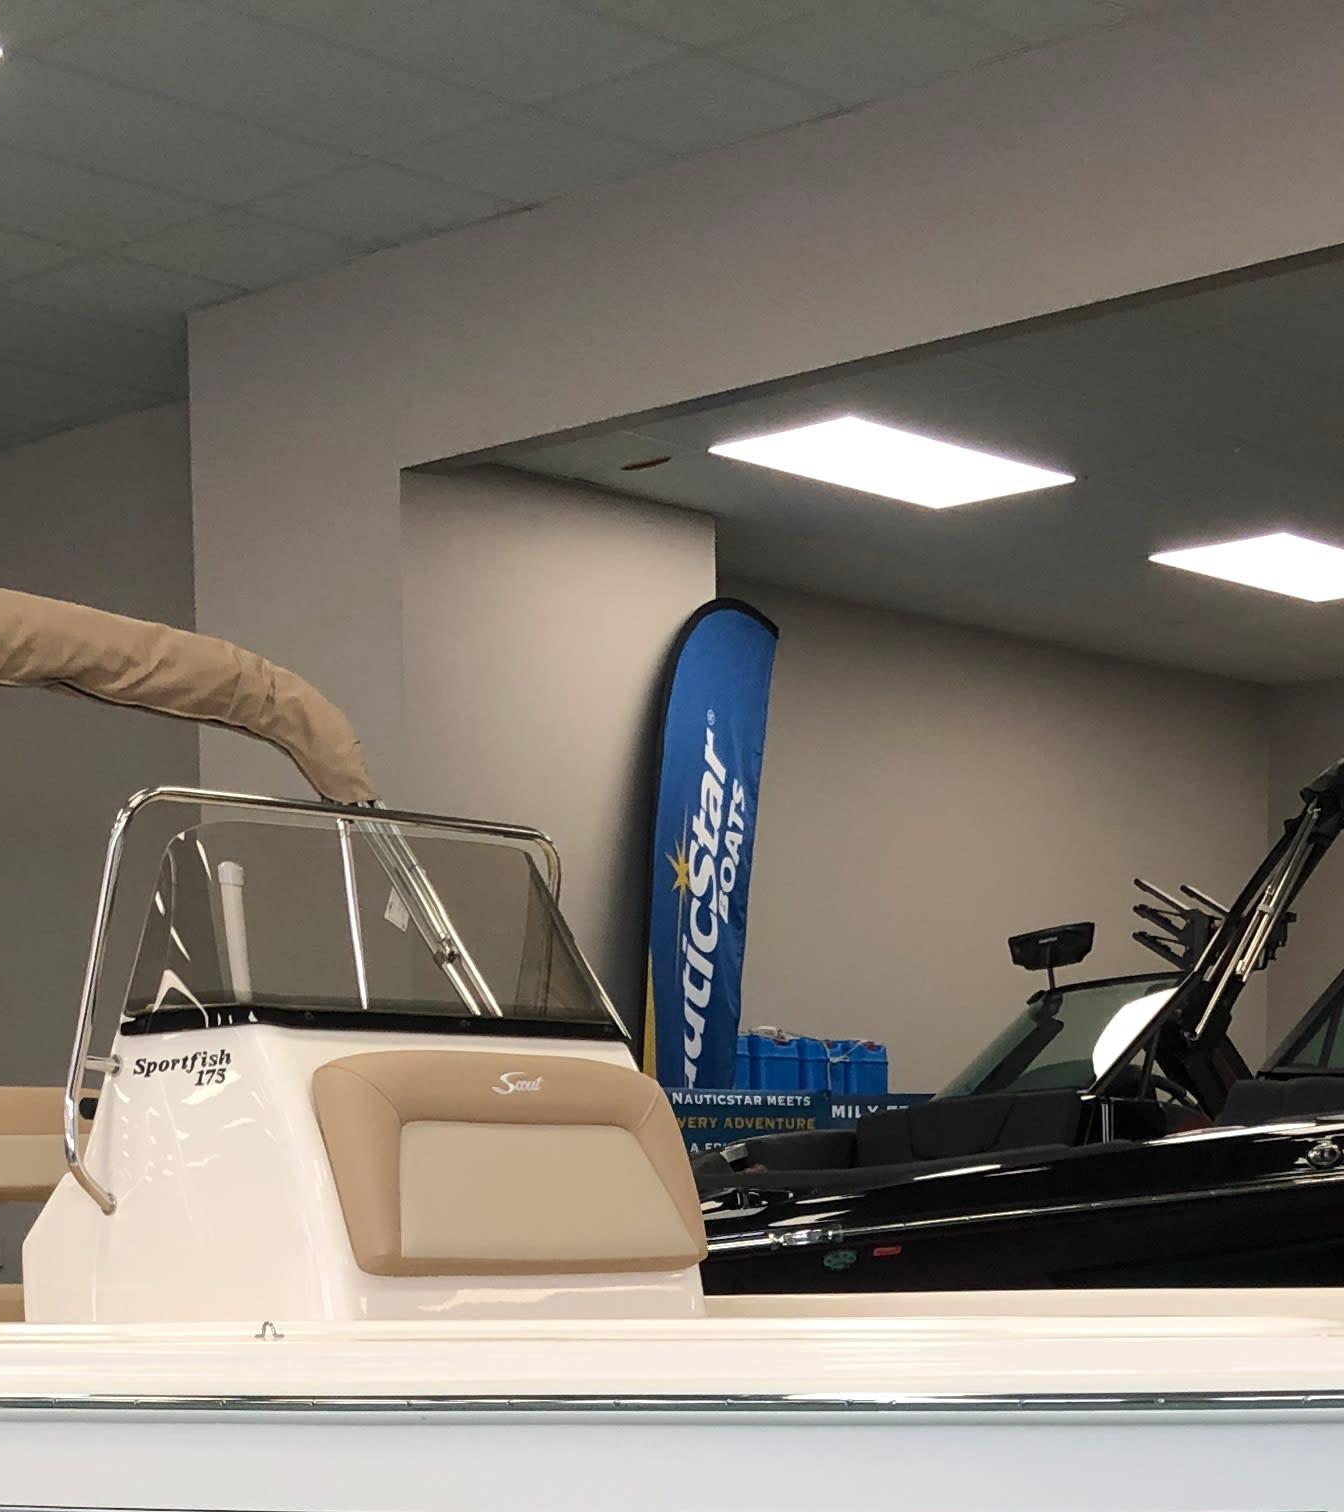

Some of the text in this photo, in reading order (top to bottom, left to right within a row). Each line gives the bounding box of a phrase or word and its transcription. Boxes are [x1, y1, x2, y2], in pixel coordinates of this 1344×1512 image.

[719, 778, 747, 925] BOATS
[132, 1049, 233, 1078] Sportfish
[193, 1068, 227, 1087] 175
[492, 1071, 545, 1095] Scout
[672, 1092, 812, 1107] NAUTICSTAR MEETS
[723, 1117, 816, 1130] ADVENTURE
